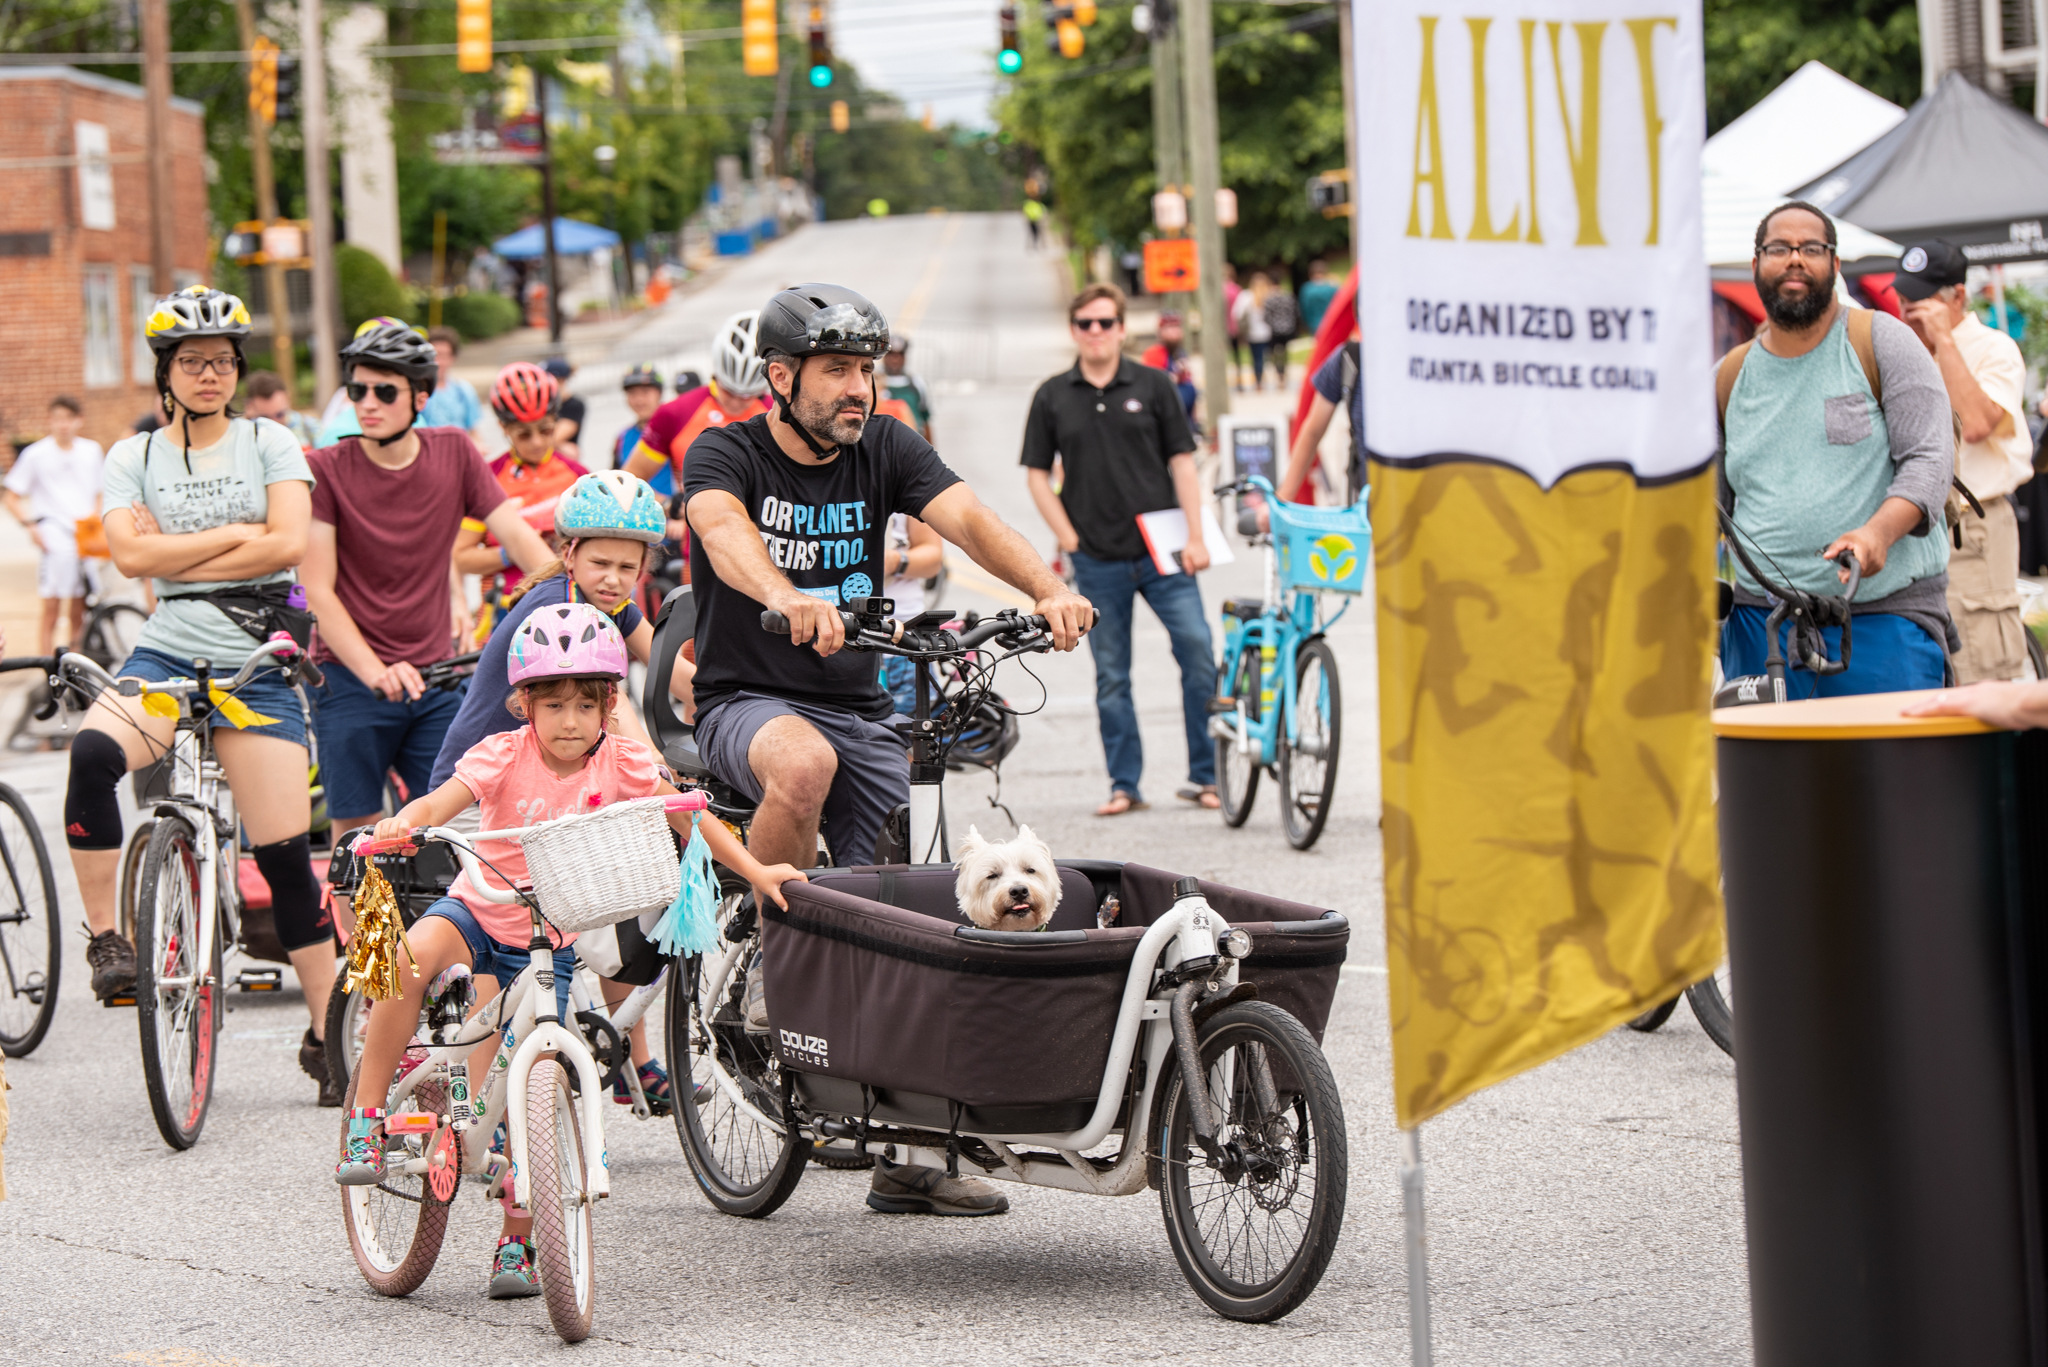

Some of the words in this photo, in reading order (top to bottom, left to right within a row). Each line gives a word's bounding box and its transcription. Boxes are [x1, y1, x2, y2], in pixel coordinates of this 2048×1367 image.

[1588, 307, 1632, 341] BY
[1494, 361, 1583, 388] BICYCLE
[174, 476, 232, 493] STREETS
[820, 537, 868, 569] TOO.
[779, 1029, 828, 1056] DOUZE
[783, 1047, 829, 1067] CYCLES
[1161, 1164, 1172, 1218] SCHWALBE
